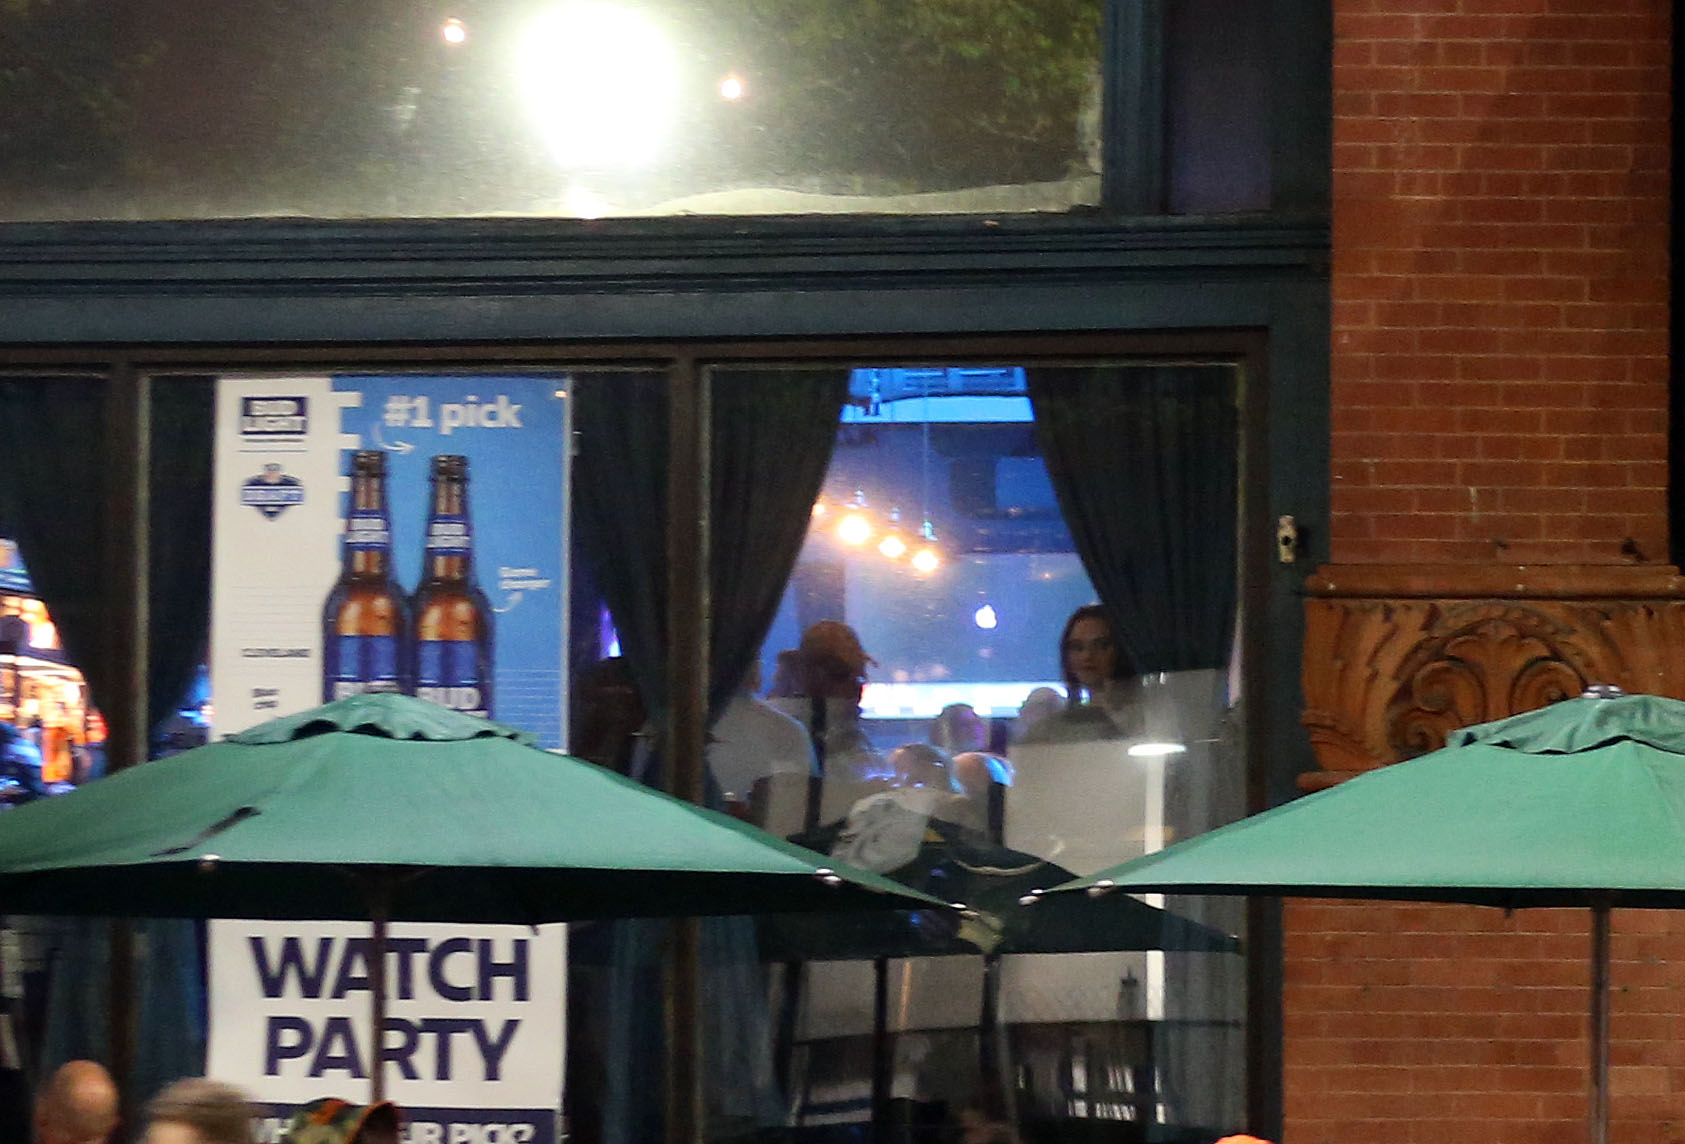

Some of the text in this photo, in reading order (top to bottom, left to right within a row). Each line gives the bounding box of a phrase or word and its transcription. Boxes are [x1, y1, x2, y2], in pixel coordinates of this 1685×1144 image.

[383, 395, 524, 435] #1 pick
[248, 936, 532, 1002] WATCH
[263, 1015, 522, 1082] PARTY
